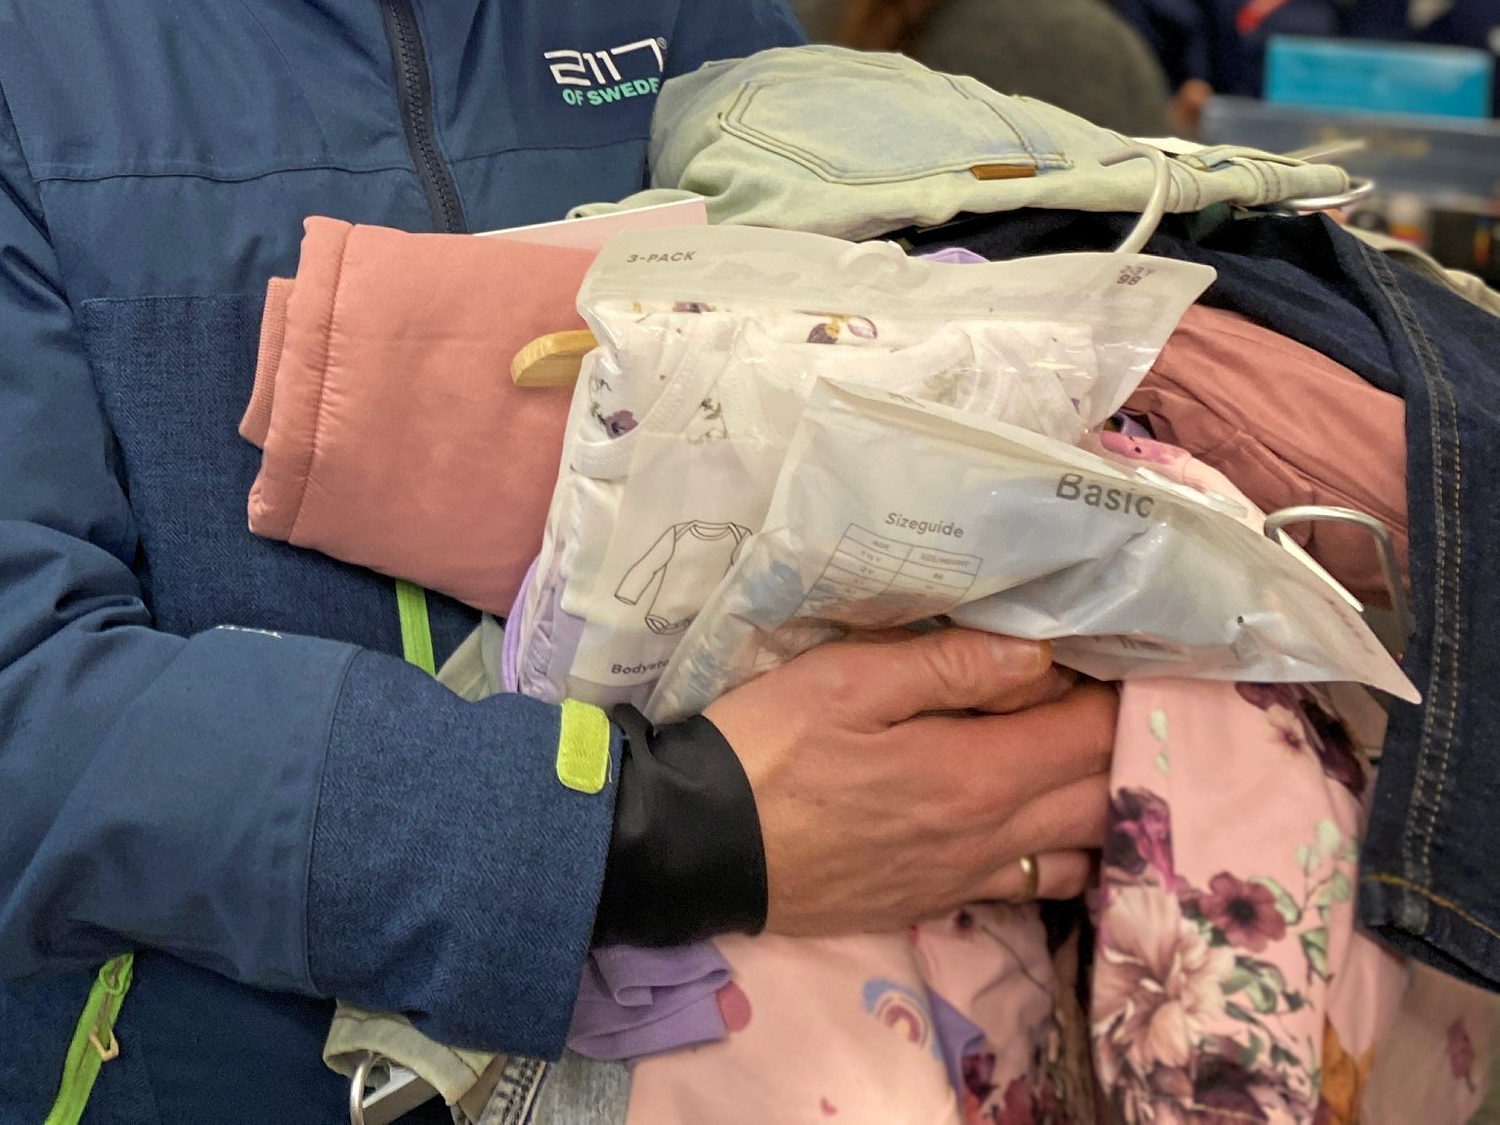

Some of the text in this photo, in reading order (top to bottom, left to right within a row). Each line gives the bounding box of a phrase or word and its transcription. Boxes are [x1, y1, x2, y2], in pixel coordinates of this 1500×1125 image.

[544, 37, 664, 86] 2117
[562, 86, 584, 106] OF
[626, 251, 697, 263] 3-PACK
[1117, 274, 1142, 286] 98
[1056, 473, 1155, 518] Basic
[885, 512, 964, 539] Sizeguide
